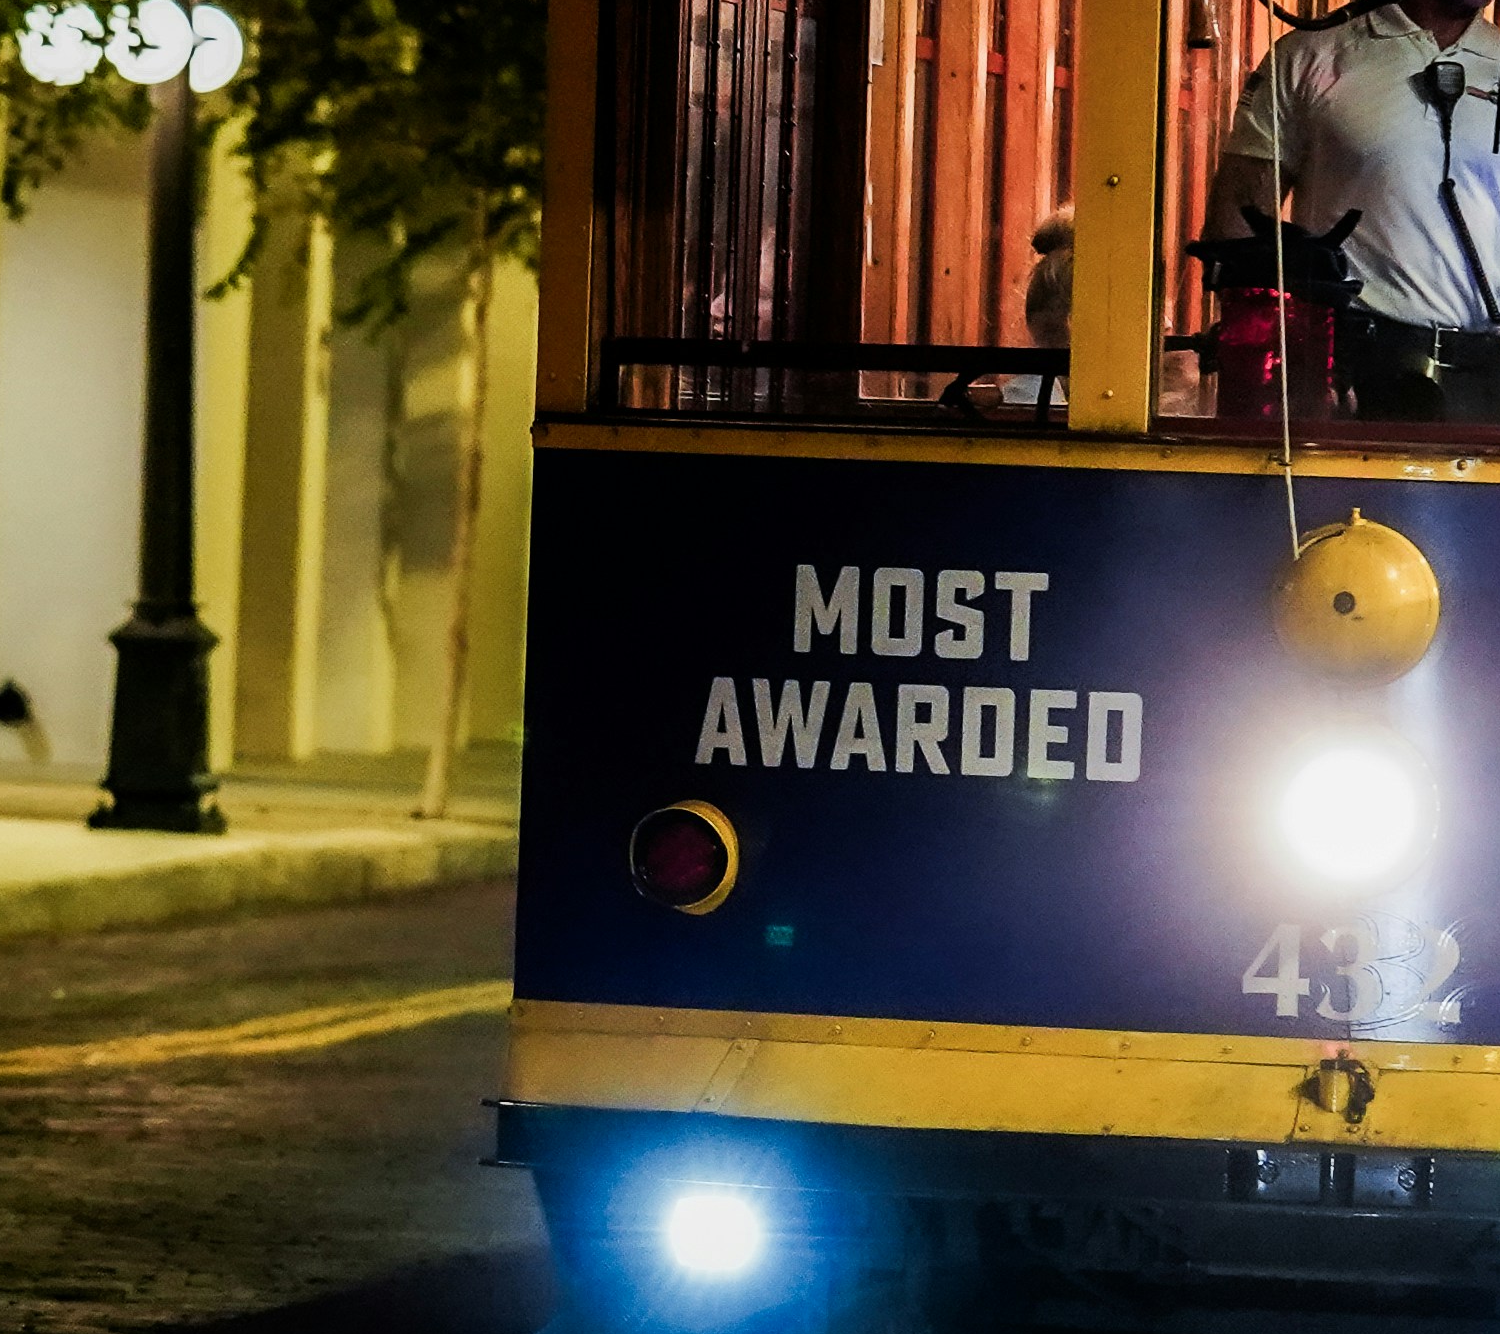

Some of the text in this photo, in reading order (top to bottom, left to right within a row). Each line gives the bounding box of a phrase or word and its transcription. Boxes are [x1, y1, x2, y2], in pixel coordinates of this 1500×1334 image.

[792, 564, 1050, 661] MOST
[694, 676, 1144, 782] AWARDED
[1241, 922, 1462, 1025] 432
